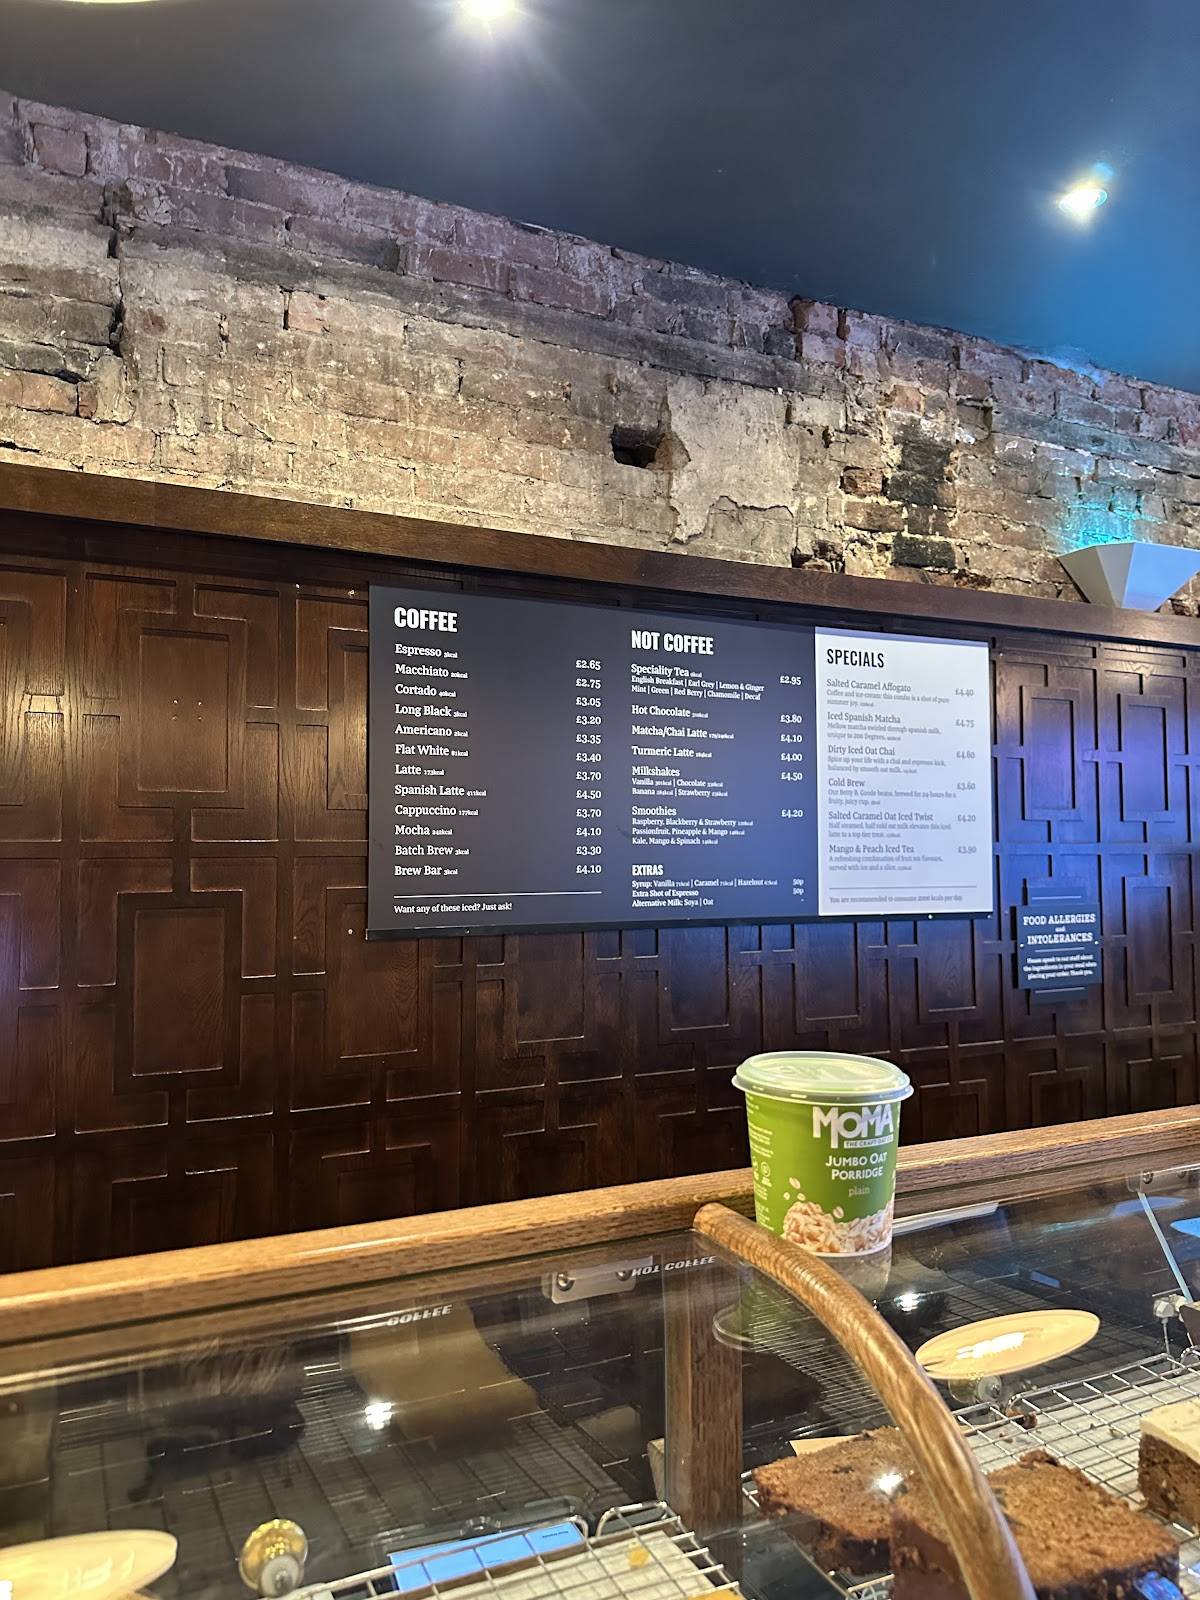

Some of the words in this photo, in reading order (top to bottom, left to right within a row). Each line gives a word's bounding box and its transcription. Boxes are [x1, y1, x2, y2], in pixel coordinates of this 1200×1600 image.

[394, 607, 457, 632] COFFEE
[632, 630, 660, 650] NOT
[664, 633, 713, 655] COFFEE
[395, 644, 442, 656] Espresso
[827, 649, 884, 668] SPECIALS
[576, 660, 600, 670] £2.65
[395, 664, 449, 677] Macchiato
[631, 664, 672, 677] Speciality
[674, 667, 689, 676] Tea
[576, 679, 601, 689] £2.75
[632, 676, 654, 684] English
[656, 677, 683, 686] Breakfast
[688, 679, 700, 687] Earl
[701, 681, 714, 689] Grey
[746, 684, 764, 692] Ginger
[780, 676, 801, 685] £2.95
[395, 684, 437, 696] Cortado
[827, 679, 849, 688] Salted
[851, 681, 880, 690] Caramel
[882, 683, 911, 693] Affogato
[687, 689, 702, 698] Berry
[708, 691, 740, 699] Chamomile
[576, 697, 601, 707] £3.05
[395, 704, 421, 717] Long
[424, 705, 452, 716] Black
[632, 705, 648, 714] Hot
[649, 706, 691, 717] Chocolate
[576, 716, 601, 725] £3.20
[780, 714, 802, 723] £3.80
[827, 712, 843, 720] Iced
[845, 713, 873, 723] Spanish
[875, 714, 900, 722] Matcha
[956, 720, 974, 728] £4.75
[395, 724, 452, 736] Americano
[632, 725, 685, 737] Matcha/Chai
[687, 728, 707, 737] Latte
[576, 734, 601, 744] £3.35
[780, 734, 802, 743] £4.10
[395, 744, 416, 754] Flat
[417, 745, 449, 755] White
[632, 746, 672, 756] Turmeric
[674, 748, 694, 757] Latte
[828, 745, 846, 755] Dirty
[848, 746, 863, 754] Iced
[865, 746, 877, 754] Oat
[879, 747, 895, 755] Chai
[576, 753, 601, 762] £3.40
[781, 753, 802, 761] £4.00
[395, 764, 421, 775] Latte
[632, 766, 680, 776] Milkshakes
[576, 772, 601, 780] £3.70
[781, 772, 802, 781] £4.50
[828, 778, 845, 786] Cold
[395, 784, 437, 796] Spanish
[439, 786, 465, 796] Latte
[576, 790, 601, 799] £4.50
[678, 789, 710, 797] Strawberry
[395, 805, 456, 817] Cappuccino
[576, 808, 601, 818] £3.70
[632, 806, 676, 815] Smoothies
[782, 809, 803, 818] £4.20
[828, 812, 850, 820] Salted
[853, 812, 882, 820] Caramel
[898, 812, 913, 820] Iced
[632, 818, 664, 826] Raspberry,
[666, 818, 697, 826] Blackberry
[705, 819, 736, 827] Strawberry
[395, 825, 430, 835] Mocha
[576, 828, 601, 837] £4.10
[672, 828, 701, 836] Pineapple
[395, 845, 424, 855] Batch
[427, 846, 453, 855] Brew
[576, 846, 601, 855] £3.30
[830, 845, 853, 854] Mango
[886, 845, 900, 853] Iced
[902, 845, 914, 853] Tea
[395, 866, 422, 875] Brew
[424, 866, 442, 875] Bar
[576, 865, 601, 874] £4.10
[632, 865, 663, 876] EXTRAS
[632, 880, 652, 888] Syrup:
[416, 906, 430, 914] any
[432, 904, 440, 912] of
[441, 904, 460, 912] these
[462, 904, 480, 912] iced?
[482, 903, 496, 911] Just
[498, 902, 512, 910] ask!
[684, 899, 698, 907] Soya
[1023, 916, 1046, 925] FOOD
[1048, 914, 1096, 924] ALLERGIES
[1027, 933, 1093, 945] INTOLERANCES
[826, 1156, 867, 1167] JUMBO
[870, 1152, 887, 1164] OAT
[832, 1167, 883, 1180] PORRIDGE
[849, 1185, 870, 1197] plain
